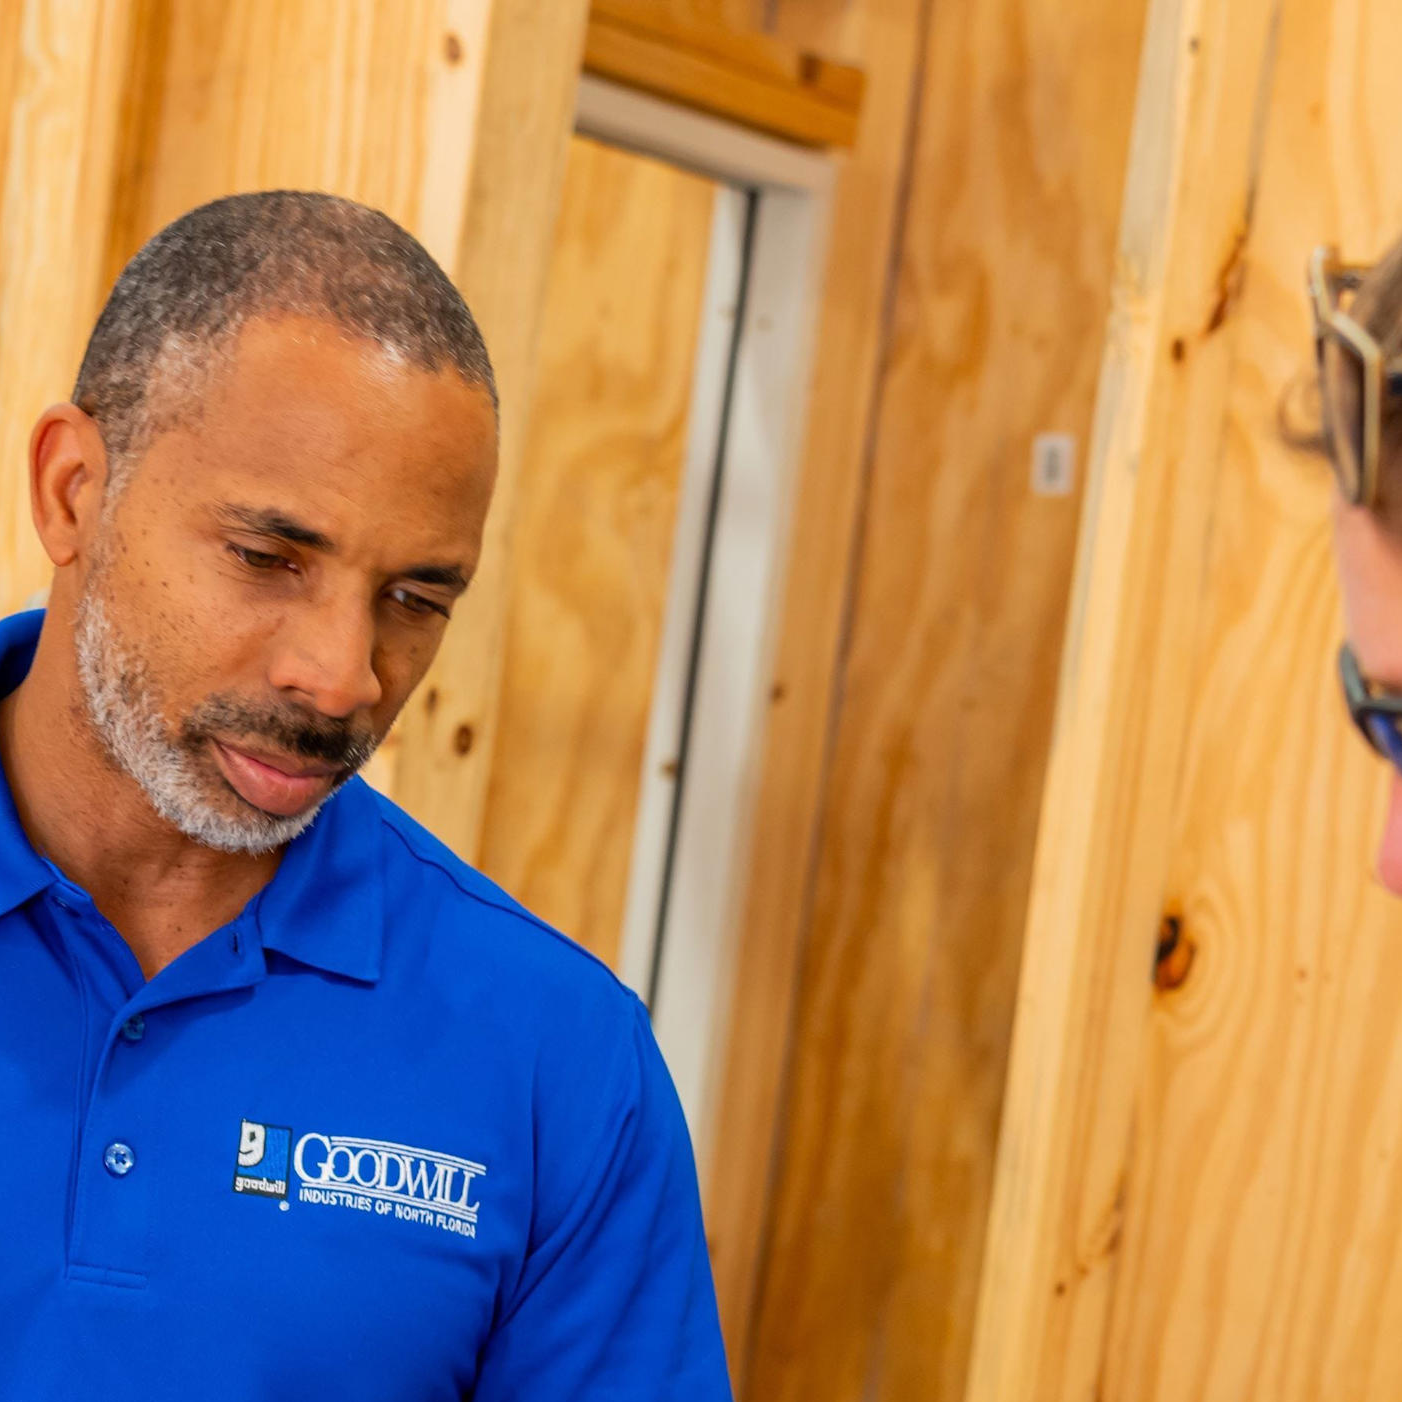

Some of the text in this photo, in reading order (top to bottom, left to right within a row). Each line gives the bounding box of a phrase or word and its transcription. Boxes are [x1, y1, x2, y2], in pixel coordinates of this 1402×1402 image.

[235, 1176, 286, 1194] goodwill
[294, 1132, 480, 1213] GOODWILL
[299, 1188, 476, 1239] INDUSTRIES OF NORTH FLORIDA
